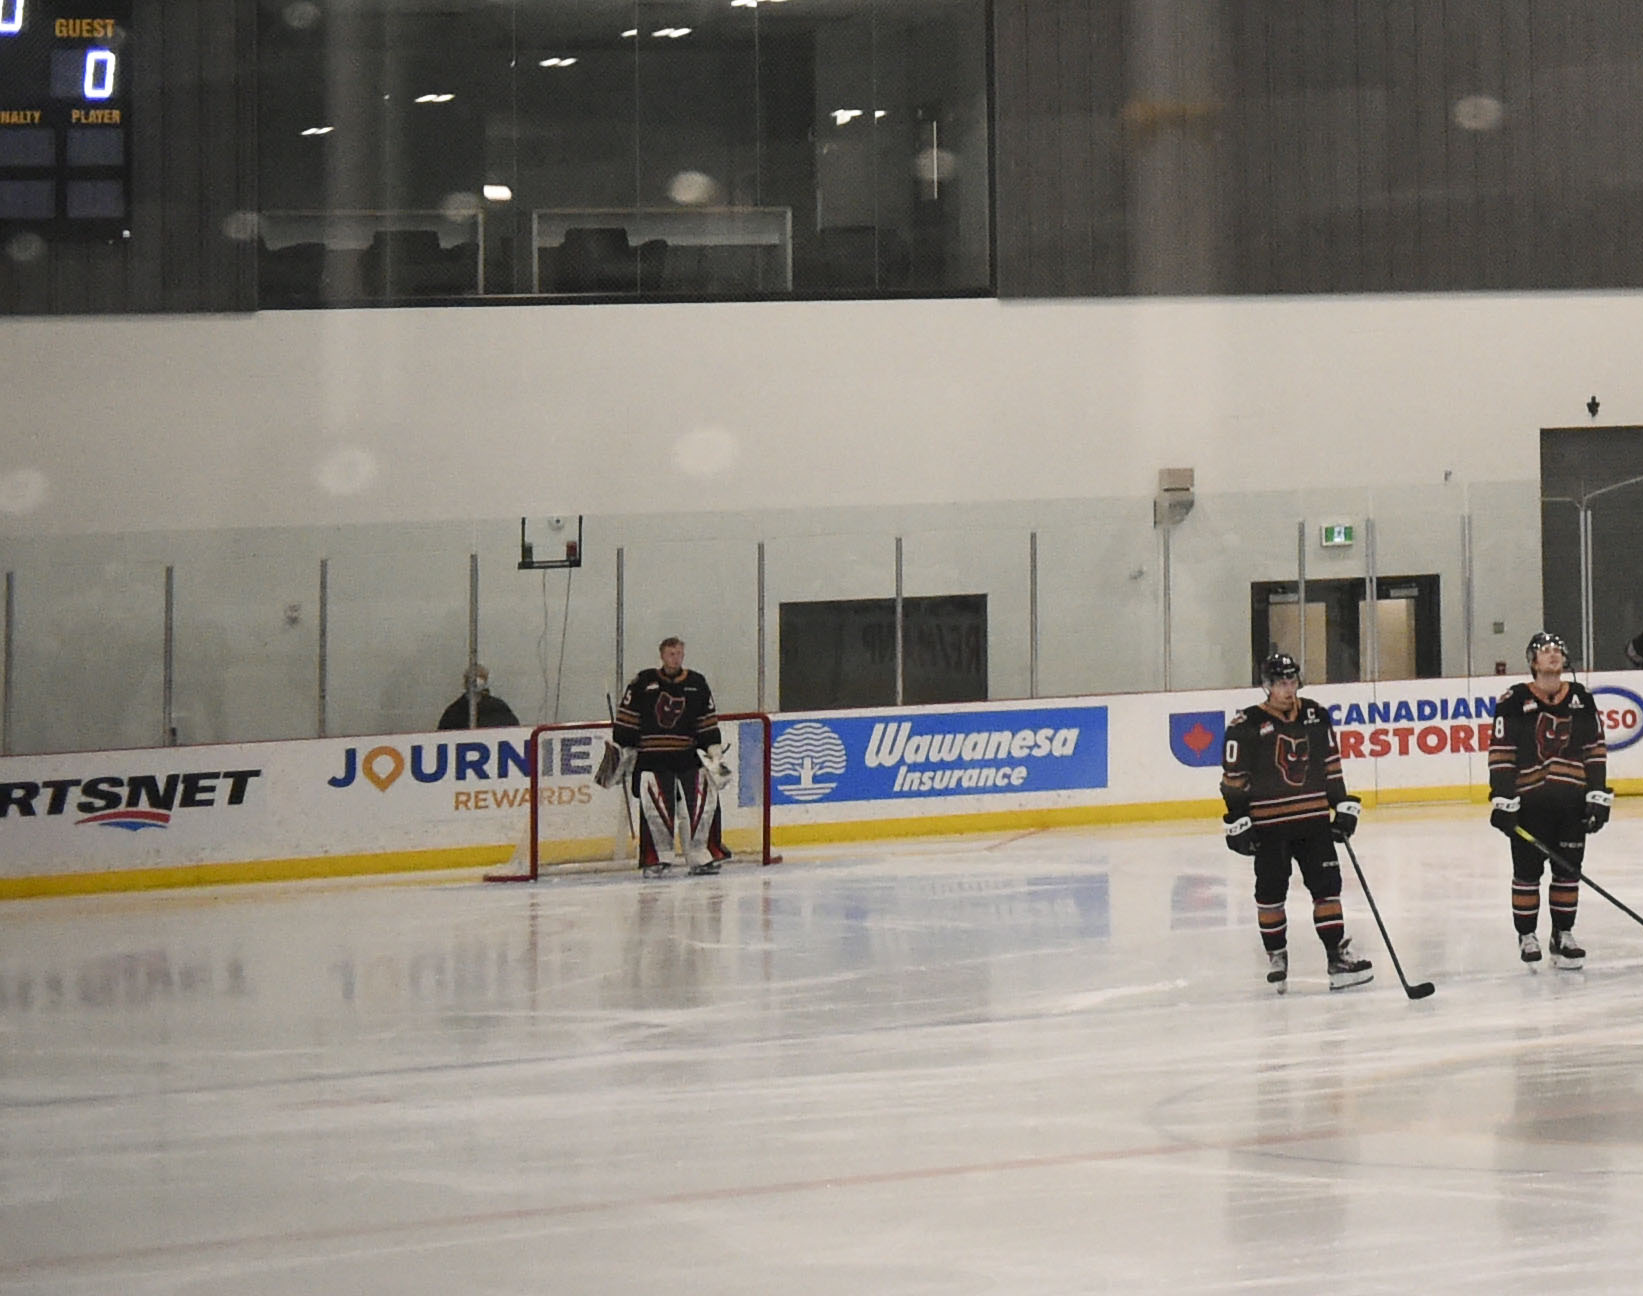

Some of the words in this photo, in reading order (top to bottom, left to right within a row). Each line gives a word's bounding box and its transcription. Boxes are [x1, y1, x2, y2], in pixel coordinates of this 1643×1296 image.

[55, 18, 116, 38] GUEST
[84, 49, 116, 99] 0
[71, 109, 121, 124] PLAYER
[1328, 696, 1497, 726] CANADIAN
[865, 722, 1080, 768] Wawanesa
[1334, 723, 1494, 760] RSTORE
[327, 736, 592, 793] JOURNIE
[893, 765, 1028, 792] Insurance
[454, 784, 592, 811] REWARDS
